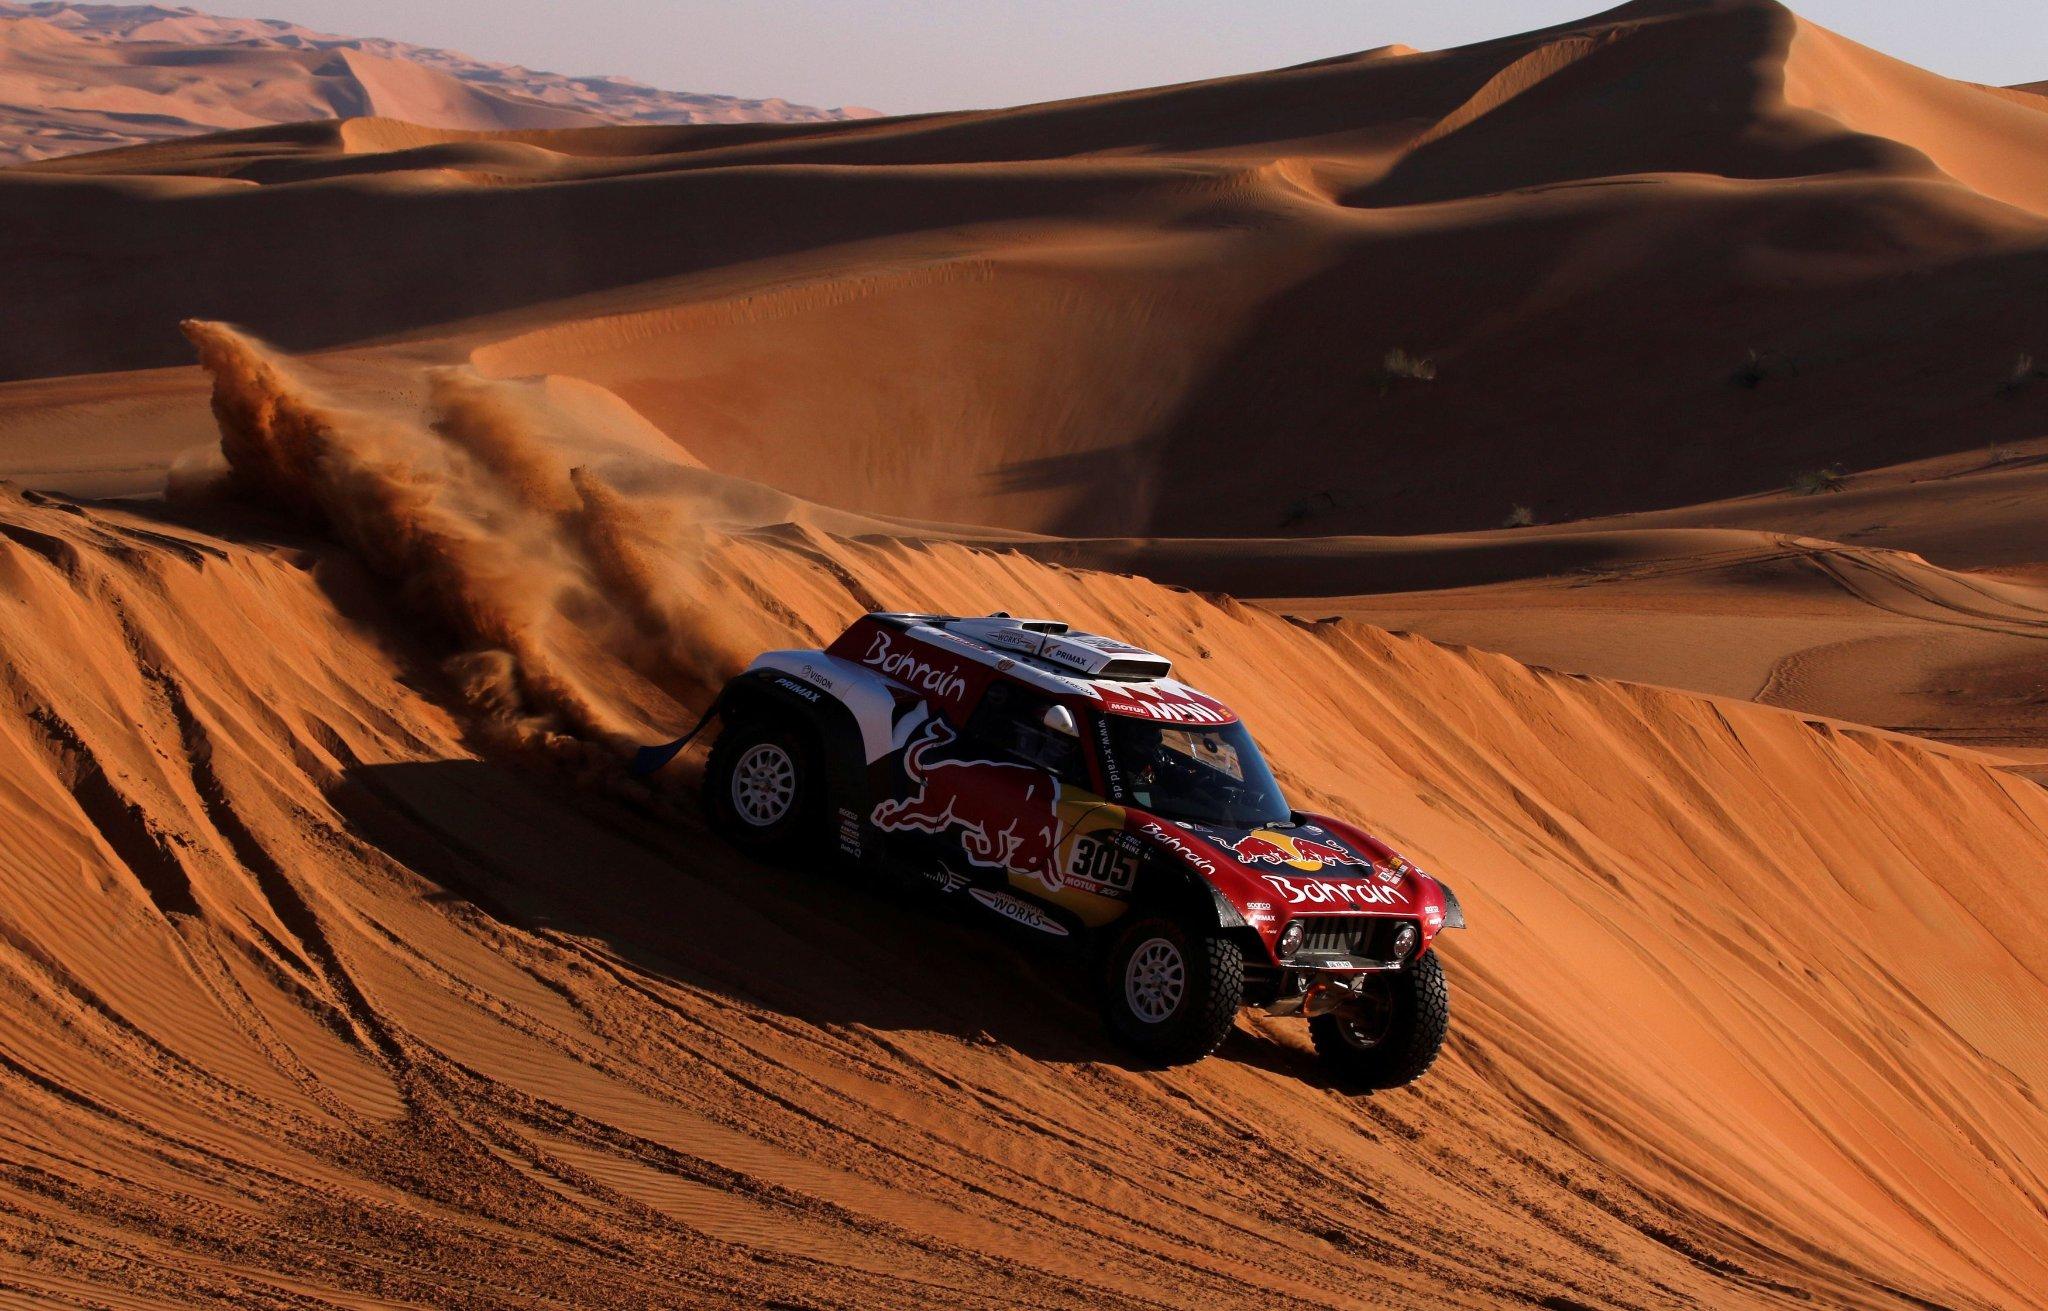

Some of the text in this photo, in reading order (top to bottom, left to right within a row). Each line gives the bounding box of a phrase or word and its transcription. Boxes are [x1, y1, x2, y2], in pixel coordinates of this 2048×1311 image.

[863, 630, 966, 702] Bahrain
[1056, 650, 1087, 665] PRIMAX
[774, 677, 821, 703] PRIMAX
[1111, 703, 1146, 714] MOTUL
[1137, 700, 1225, 722] MINI
[1098, 719, 1123, 800] www.x-raid.de
[1072, 838, 1131, 887] 305
[1140, 822, 1216, 875] Bahrain
[1064, 877, 1097, 893] MOTUL
[1261, 874, 1410, 906] Bahrain
[994, 897, 1042, 926] WORKS
